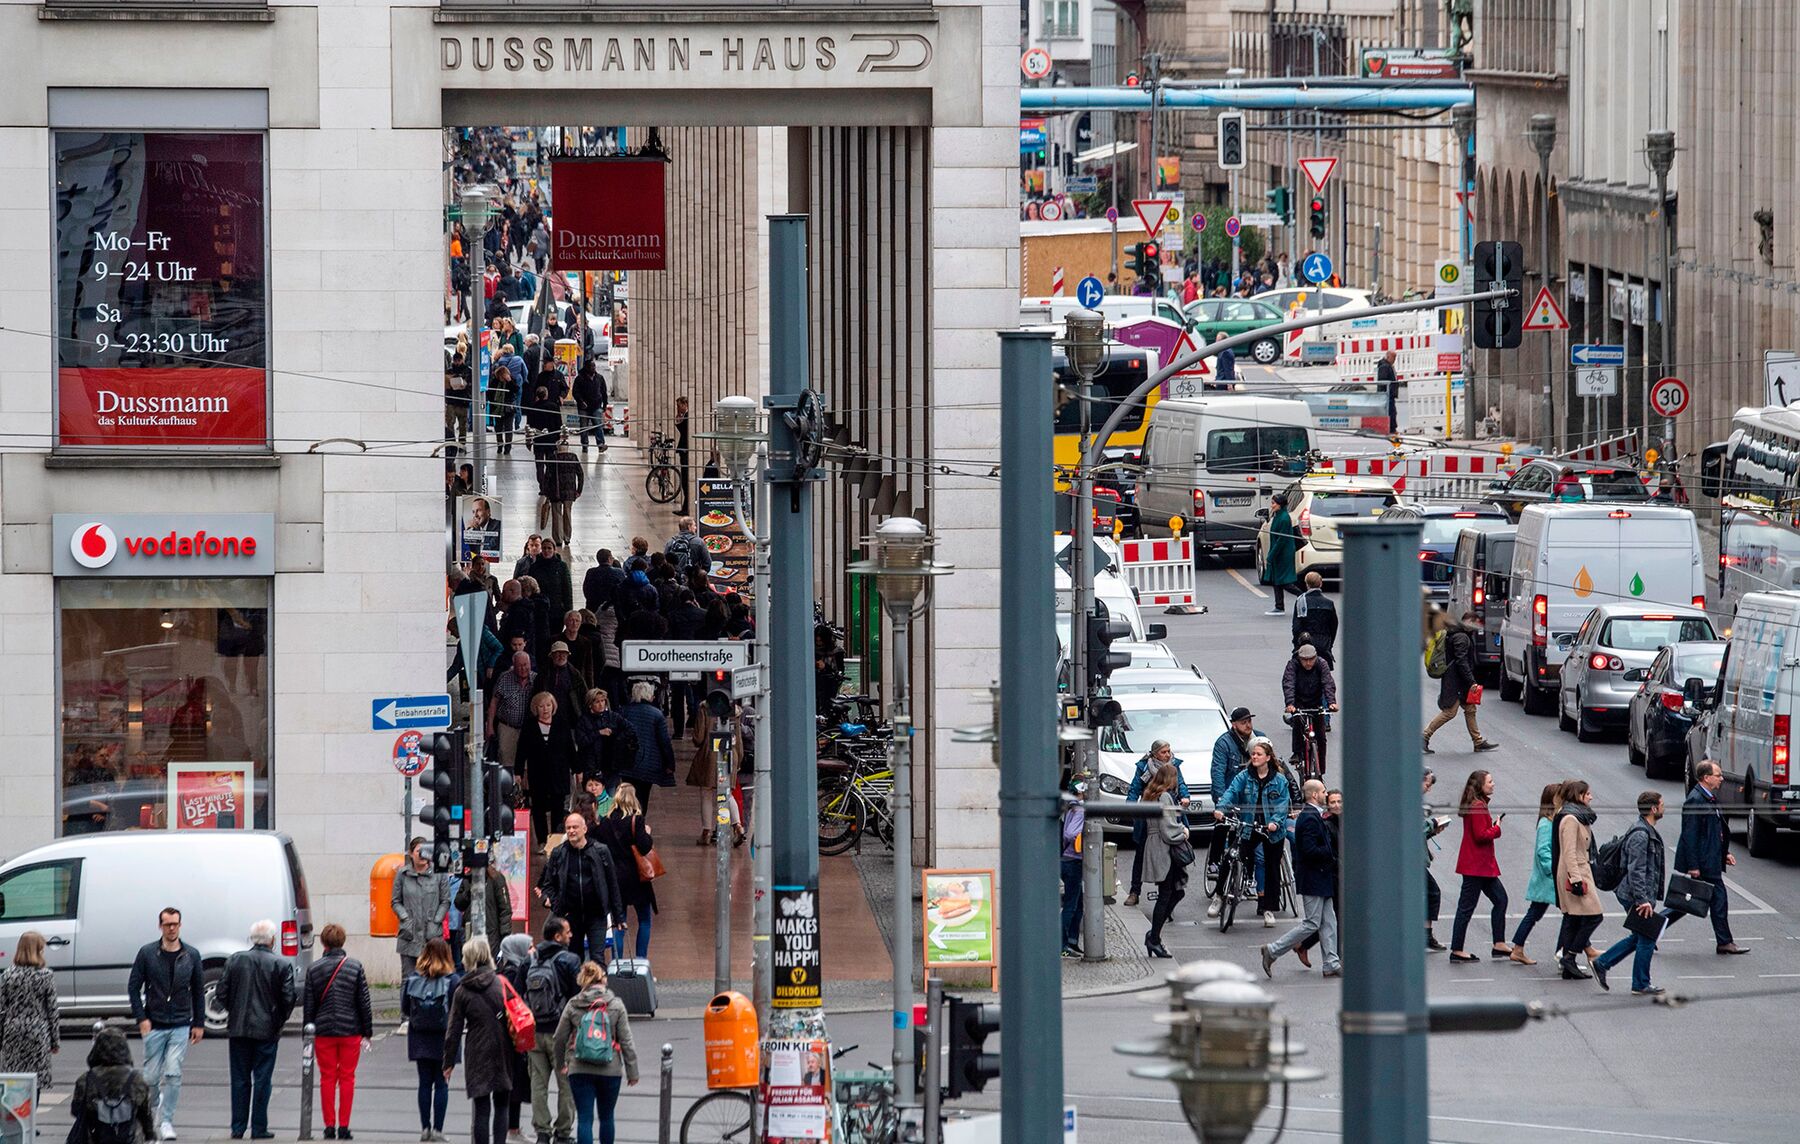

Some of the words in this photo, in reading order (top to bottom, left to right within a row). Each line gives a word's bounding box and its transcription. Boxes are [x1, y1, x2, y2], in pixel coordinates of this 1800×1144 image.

[441, 37, 836, 72] DUSSMANN-HAUS
[559, 230, 661, 248] Dussmann
[559, 249, 577, 260] das
[580, 249, 661, 260] KulturKaufhaus
[156, 262, 197, 281] Uhr
[96, 303, 122, 323] Sa
[189, 333, 229, 353] Uhr
[97, 391, 230, 413] Dussmann
[1659, 388, 1681, 406] 30
[98, 415, 115, 426] das
[118, 415, 197, 426] KulturKaufhaus
[125, 531, 257, 556] vodafone
[638, 648, 733, 664] Dorotheenstraße
[394, 707, 446, 718] Einbahnstraße
[183, 796, 204, 807] LAST
[205, 792, 234, 803] MINUTE
[185, 799, 236, 820] DEALS
[775, 918, 818, 934] MAKES
[784, 935, 812, 951] YOU
[774, 950, 819, 967] HAPPY!
[776, 985, 819, 997] DILDOKING
